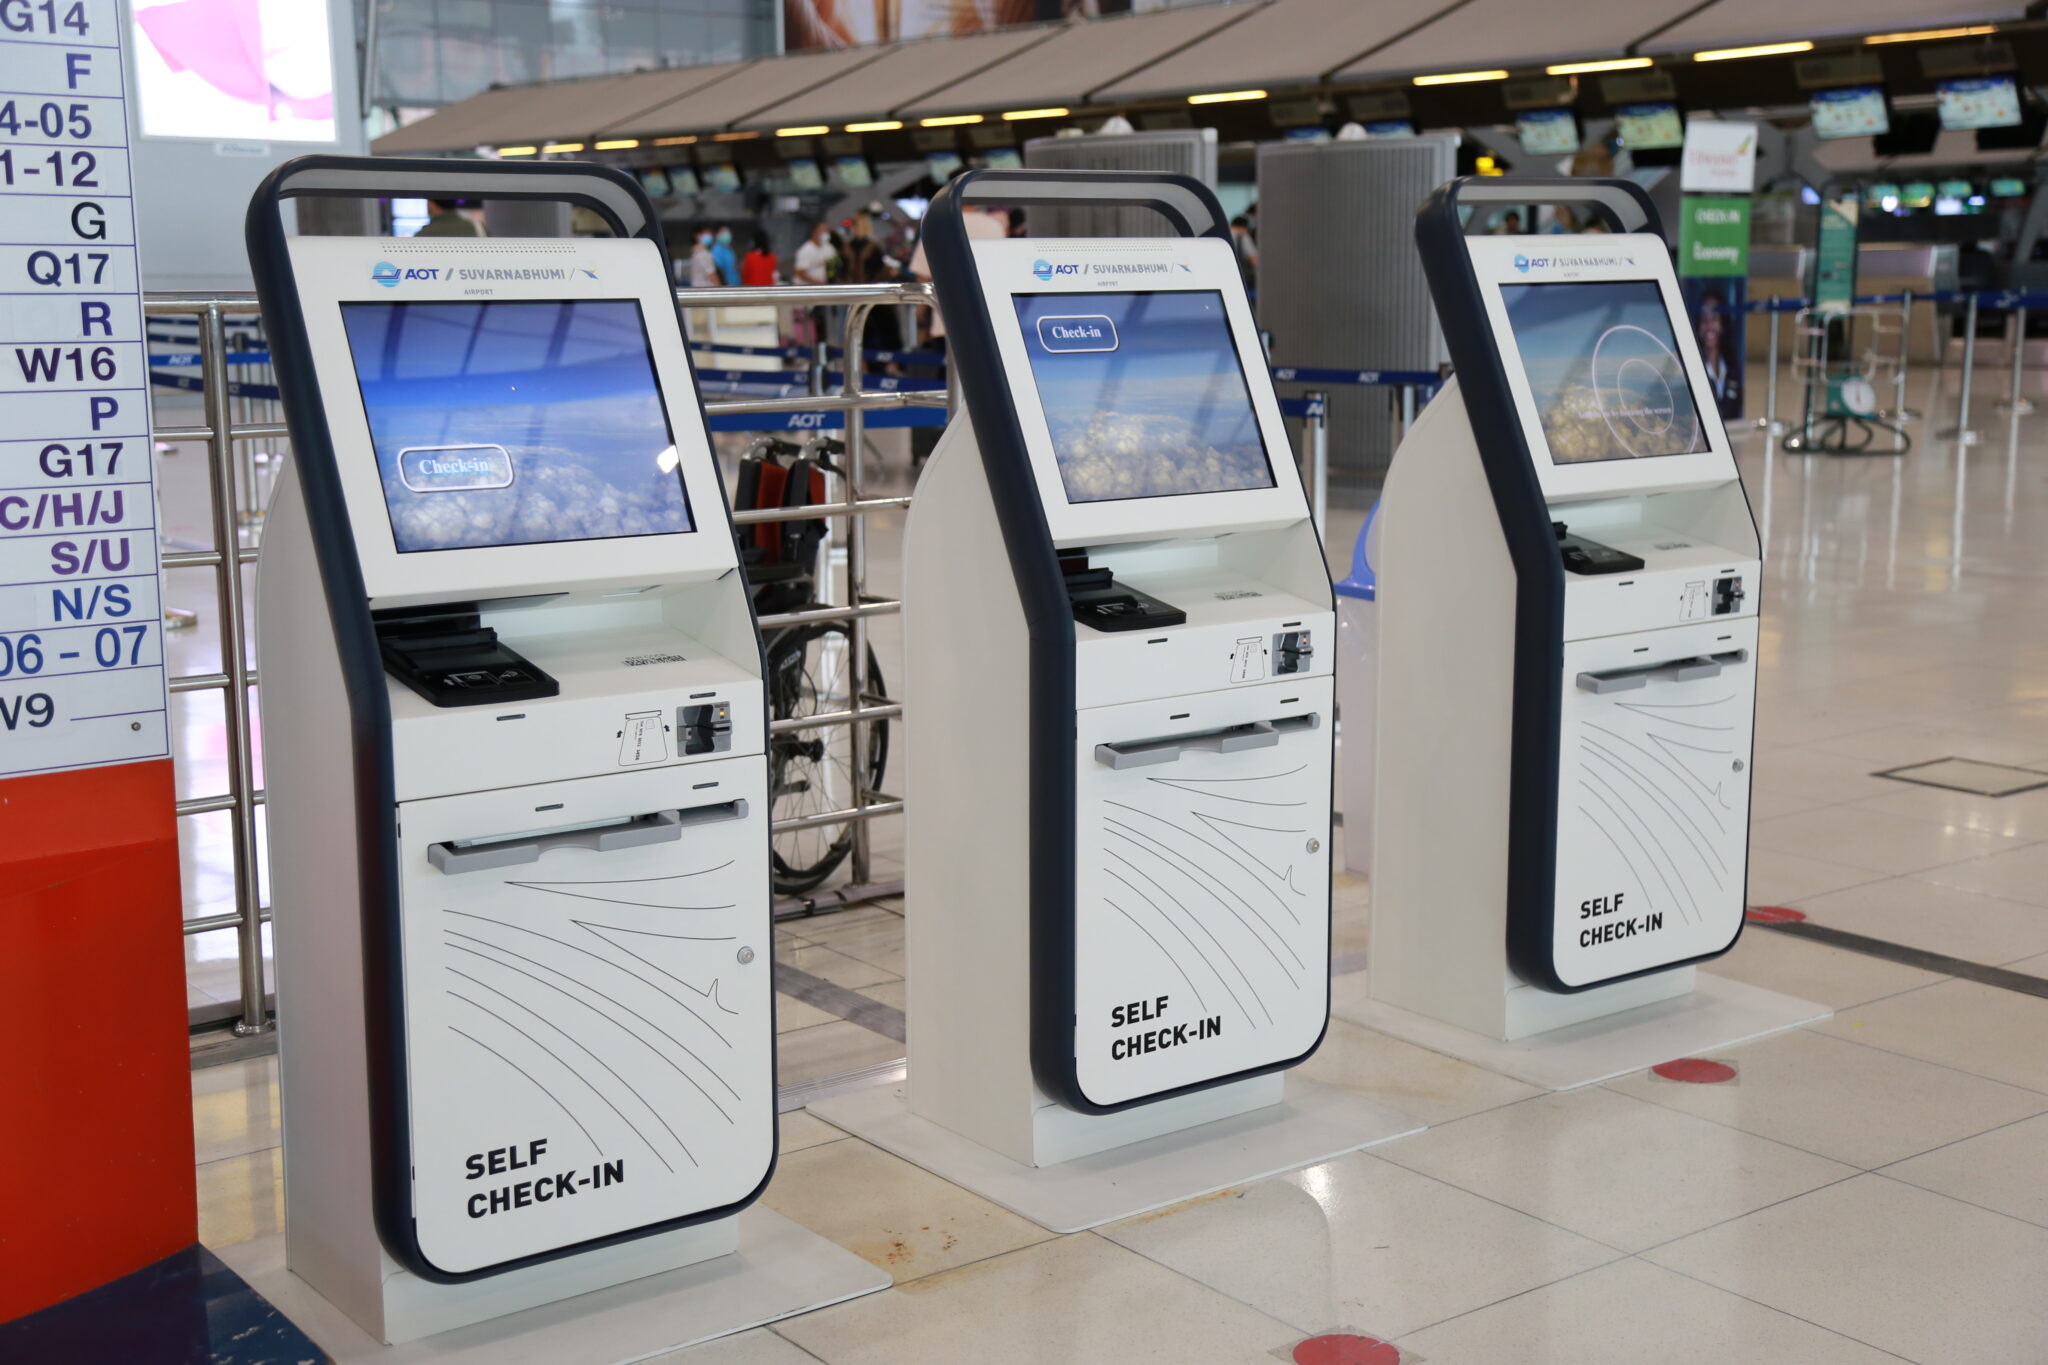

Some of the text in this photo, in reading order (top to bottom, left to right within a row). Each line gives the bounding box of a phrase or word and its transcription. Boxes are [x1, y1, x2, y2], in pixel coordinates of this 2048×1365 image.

[0, 0, 89, 35] G14
[66, 53, 91, 89] F
[71, 202, 106, 240] G
[27, 251, 109, 287] Q17
[404, 268, 565, 280] AOT SUVARNABHUMI
[1056, 264, 1168, 274] AOT SUVARNABHUMI
[1531, 258, 1549, 267] AOT
[81, 301, 113, 336] R
[1052, 326, 1102, 339] Check-in
[16, 347, 117, 382] W16
[90, 397, 119, 431] P
[787, 414, 826, 428] AOT
[39, 442, 124, 478] G17
[420, 458, 488, 475] Check-in
[0, 490, 124, 530] C/H/J
[51, 538, 130, 575] S/U
[53, 584, 132, 622] N/S
[1580, 893, 1624, 919] SELF
[1580, 912, 1662, 948] CHECK-IN
[1111, 995, 1168, 1028] SELF
[1111, 1015, 1220, 1060] CHECK-IN
[465, 1138, 547, 1180] SELF
[467, 1159, 624, 1219] CHECK-IN
